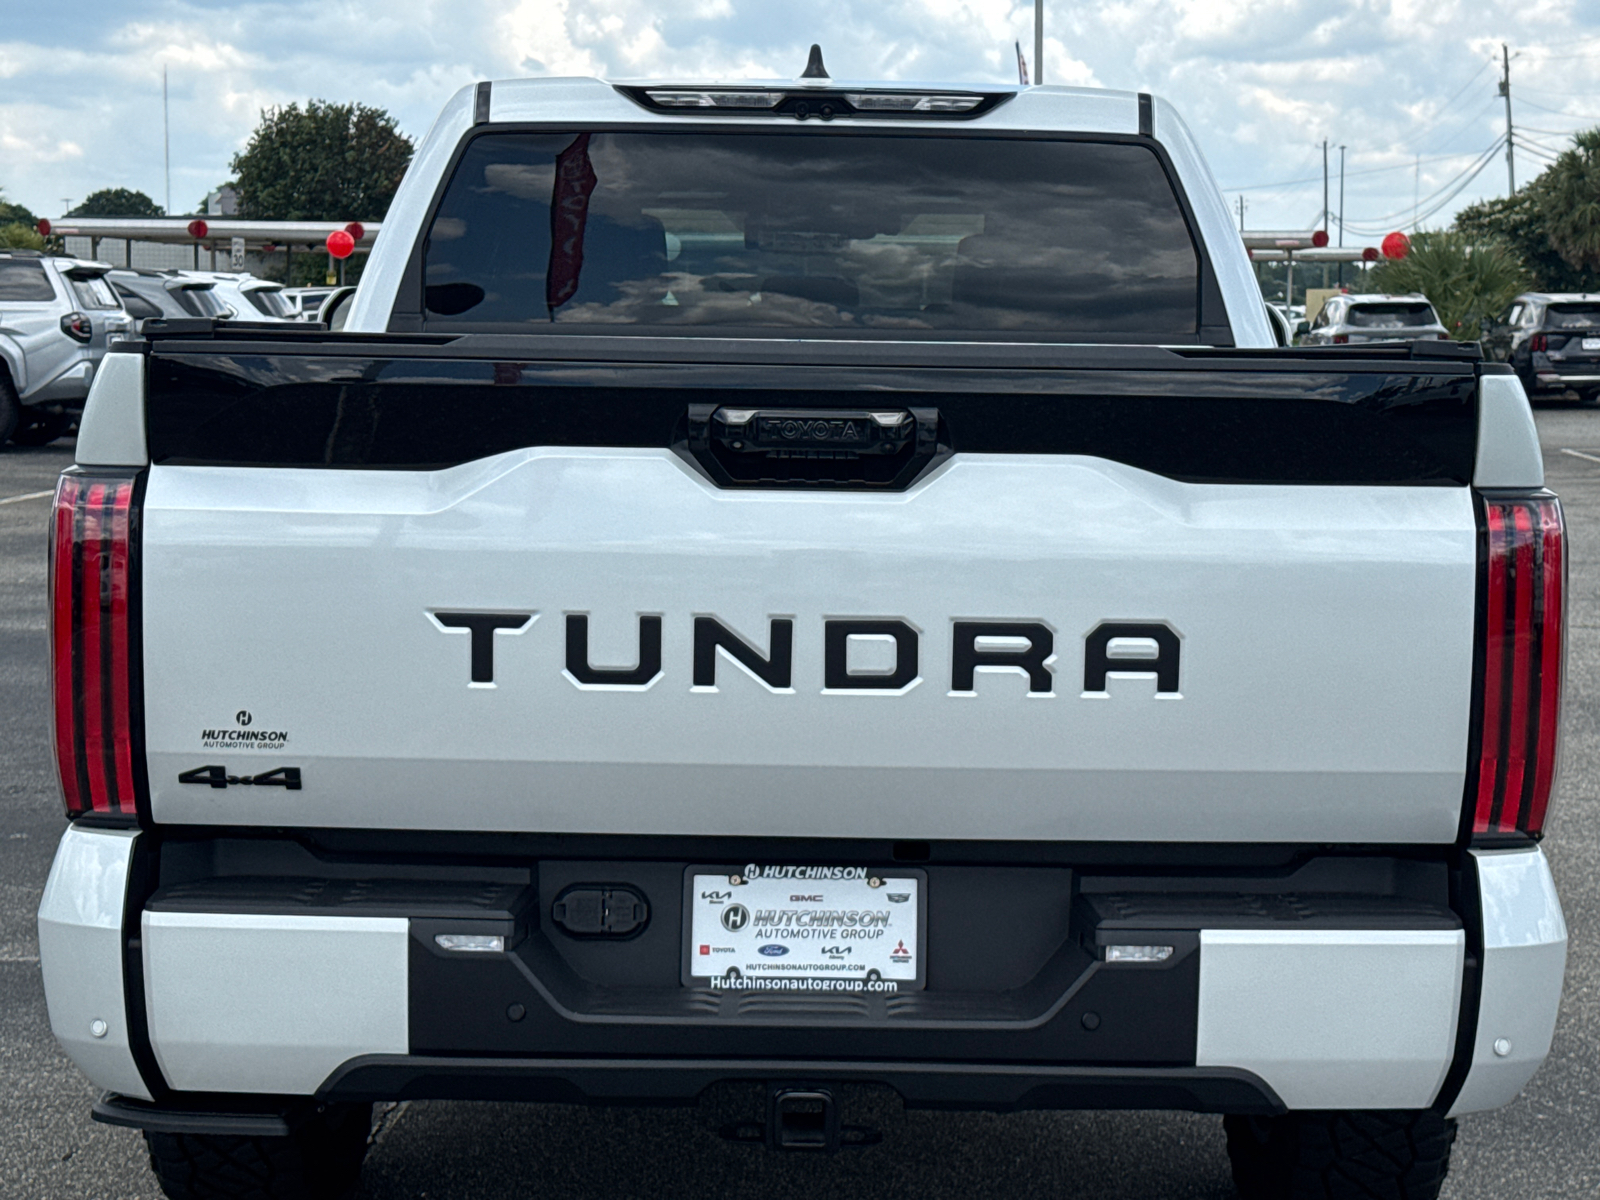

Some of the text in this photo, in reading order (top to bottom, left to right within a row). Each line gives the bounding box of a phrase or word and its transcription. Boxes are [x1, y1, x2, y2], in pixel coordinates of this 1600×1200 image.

[233, 253, 243, 267] 30
[767, 419, 860, 441] TOYOTA
[426, 609, 1183, 698] TUNDRA
[201, 729, 288, 742] HUTCHINSON
[203, 740, 285, 750] AUTOMOTIVE GROUP
[763, 865, 868, 880] HUTCHINSON
[789, 894, 824, 902] GMC
[753, 909, 891, 928] HUTCHINSON
[755, 928, 885, 940] AUTOMOTIVE GROUP
[745, 963, 866, 972] HUTCHINSONAUTOGROUP.COM
[710, 975, 898, 993] Hutchinsonautogroup.com
